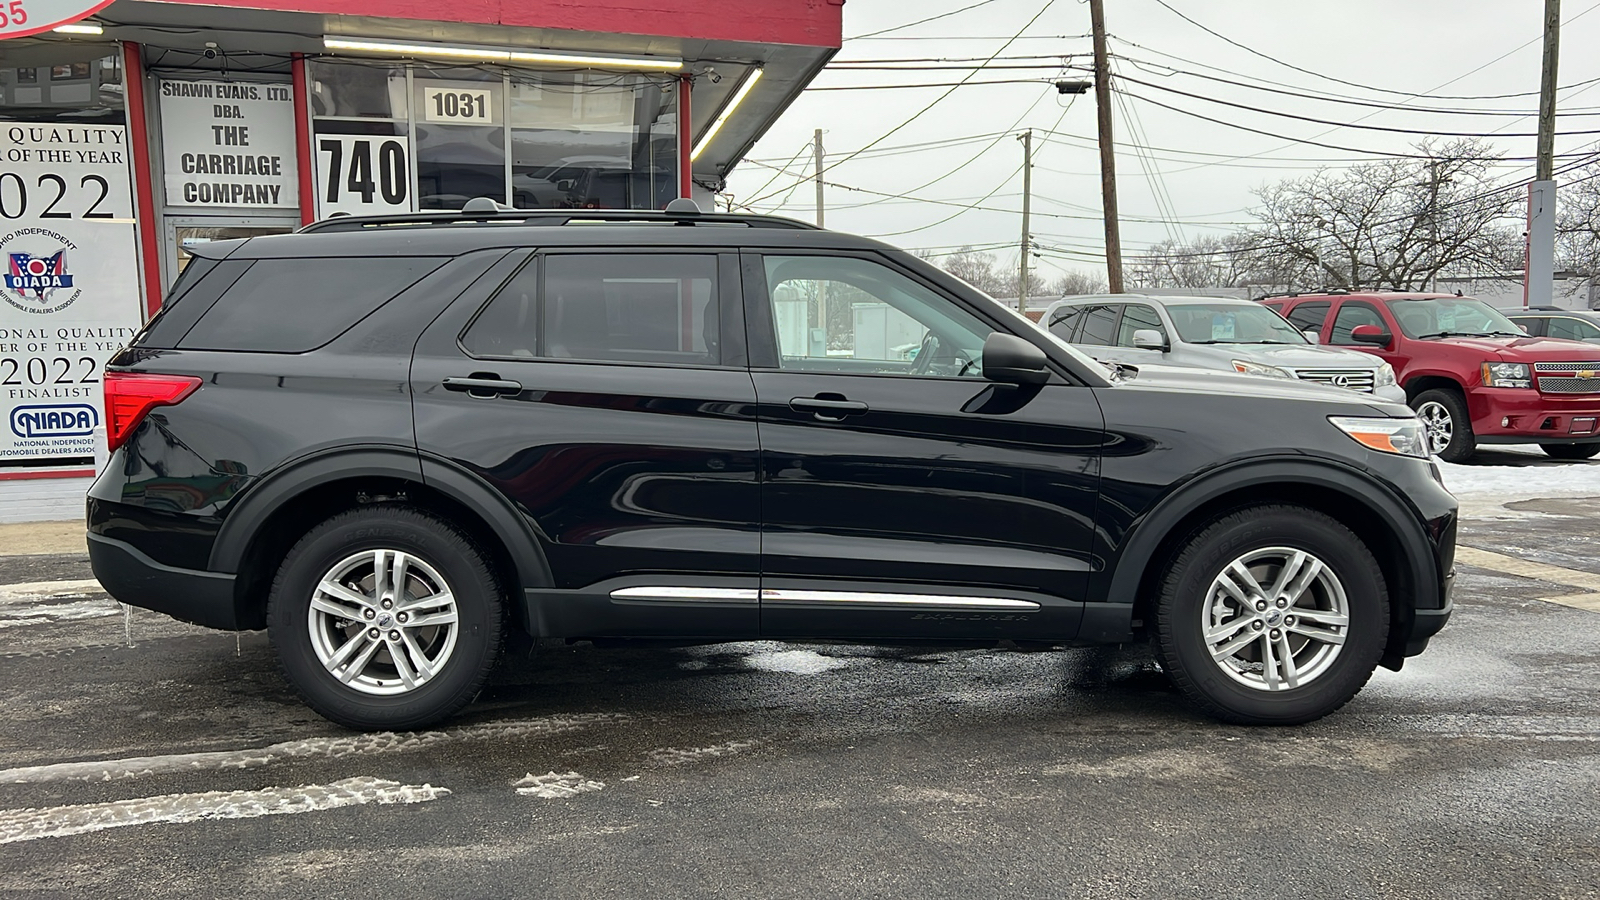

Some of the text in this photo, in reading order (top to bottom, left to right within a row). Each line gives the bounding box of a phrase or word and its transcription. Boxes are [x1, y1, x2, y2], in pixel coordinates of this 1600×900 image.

[163, 82, 292, 102] SHAWN EVANS. LTD.
[213, 104, 244, 119] DBA.
[432, 92, 485, 118] 1031
[8, 127, 123, 145] QUALITY
[211, 125, 249, 147] THE
[7, 148, 123, 164] OF THE YEAR
[181, 153, 281, 176] CARRIAGE
[320, 139, 407, 205] 740
[0, 172, 114, 219] 022
[183, 182, 281, 205] COMPANY
[14, 227, 77, 251] INDEPENDENT
[12, 275, 62, 288] OIADA
[29, 306, 54, 315] DEALERS
[54, 288, 82, 312] ASSOCIATION
[57, 327, 138, 341] QUALITY
[27, 342, 48, 353] OF
[55, 342, 87, 352] THE
[95, 341, 127, 352] YEA
[0, 356, 99, 386] 2022
[9, 387, 92, 399] FINALIST
[17, 410, 91, 434] NIADA
[14, 440, 50, 448] NATIONAL
[41, 447, 72, 455] DEALERS
[344, 528, 429, 548] GENERAL
[911, 613, 1029, 622] EXPLORER
